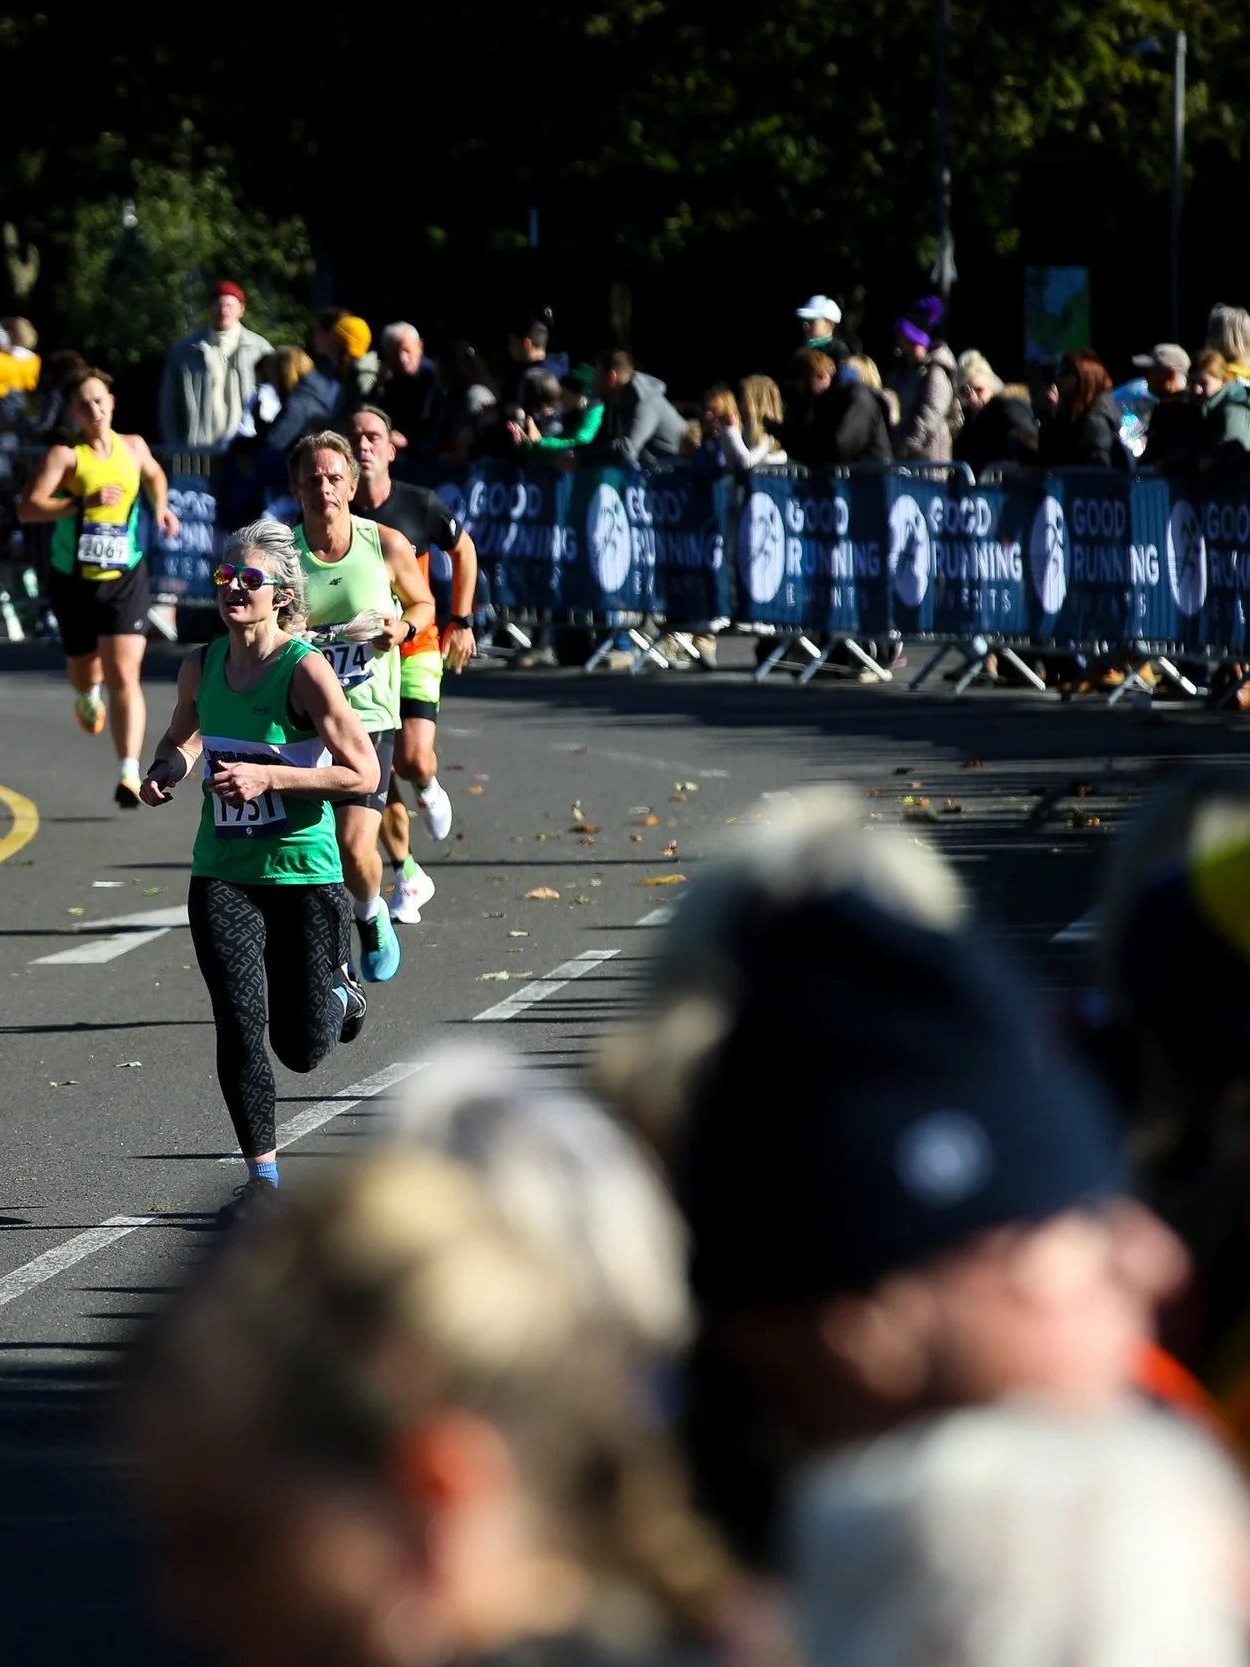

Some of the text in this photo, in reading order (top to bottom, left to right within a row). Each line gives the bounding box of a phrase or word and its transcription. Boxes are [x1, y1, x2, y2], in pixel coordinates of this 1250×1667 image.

[786, 496, 849, 536] GOOD
[929, 496, 991, 537] GOOD
[1072, 497, 1126, 538] GOOD
[1206, 501, 1250, 544] GOO
[786, 538, 880, 580] RUNNING
[933, 541, 1023, 583] RUNNING
[1072, 543, 1160, 587] RUNNING
